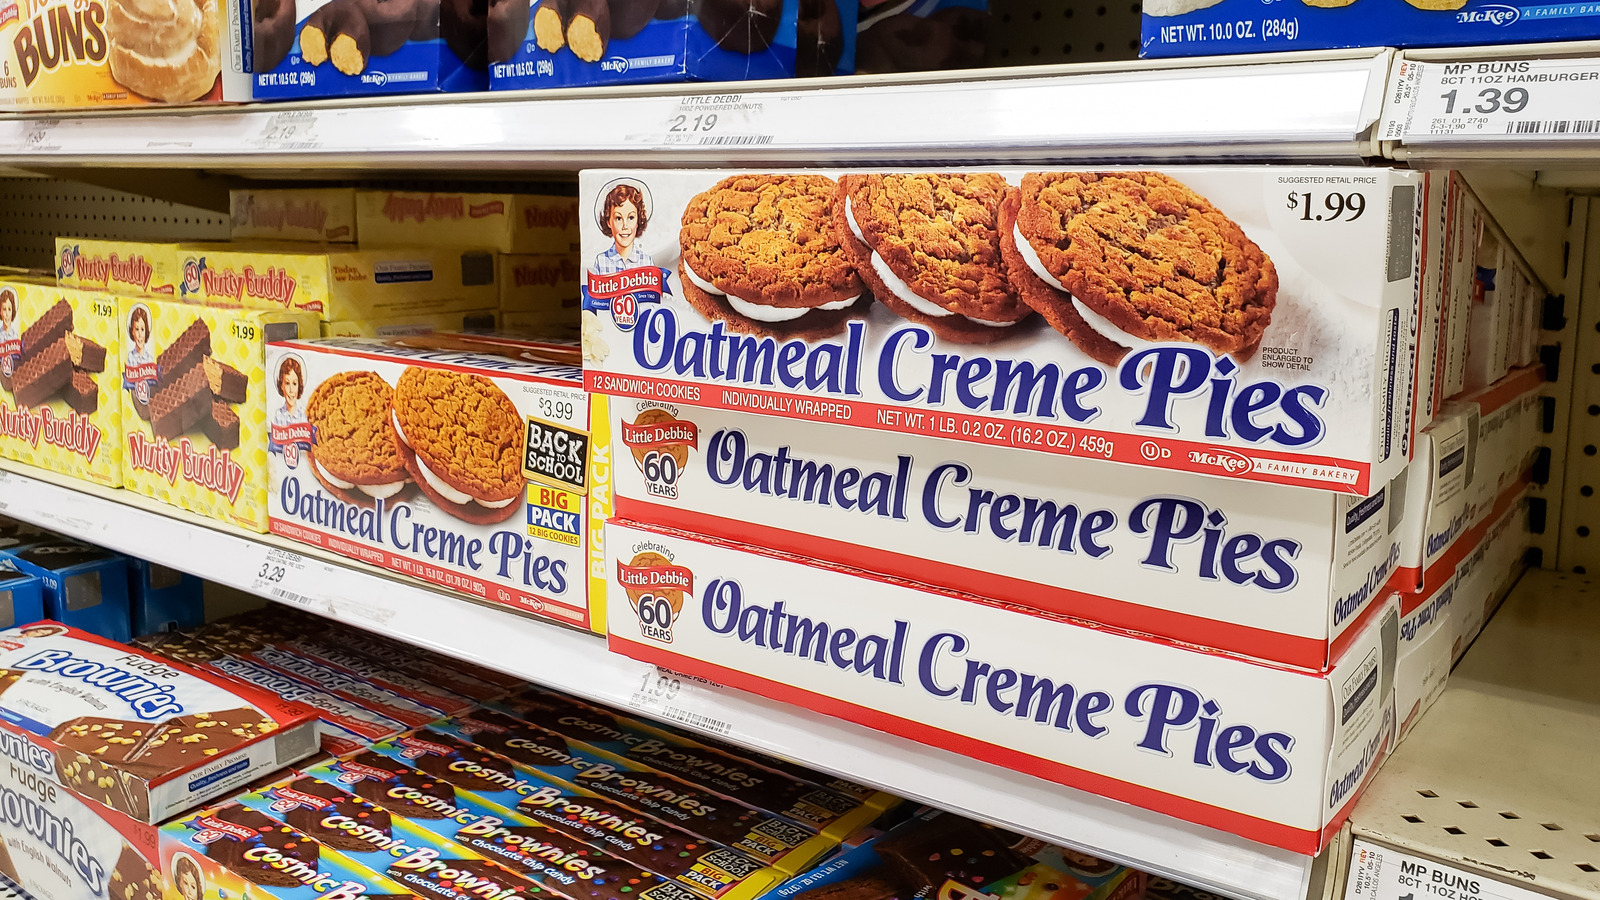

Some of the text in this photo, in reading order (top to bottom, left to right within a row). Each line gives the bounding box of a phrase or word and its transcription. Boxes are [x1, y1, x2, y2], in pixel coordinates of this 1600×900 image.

[1456, 10, 1515, 26] McKee
[1535, 6, 1575, 16] FAMILY
[1161, 17, 1299, 43] NET WT. 10.0 OZ. (284g)
[14, 2, 107, 88] BUNS
[4, 61, 10, 76] 6
[494, 62, 536, 79] NET WT. OZ.
[601, 61, 627, 74] McKee
[1399, 62, 1408, 77] REV
[1407, 63, 1416, 81] 05-10
[1443, 62, 1530, 75] MP BUNS
[0, 77, 17, 88] BUNS
[258, 73, 289, 86] NET WT. 10.5
[361, 74, 386, 86] McKee
[1440, 72, 1599, 85] 8CT HAMBURGER
[681, 96, 711, 105] LITTLE
[1440, 87, 1530, 114] 1.39
[266, 125, 297, 140] 2.19
[669, 113, 718, 132] 2.19
[1277, 176, 1377, 184] SUGGESTED RETAIL PRICE
[1286, 190, 1366, 222] $1.99
[76, 251, 154, 292] Nutty Buddy
[184, 264, 199, 283] 60
[202, 265, 297, 309] Nutty Buddy
[590, 272, 659, 294] Little Debbie
[93, 303, 113, 318] $1.99
[613, 296, 635, 317] 60
[615, 315, 635, 324] YEARS
[231, 323, 255, 341] $1.99
[1262, 346, 1298, 355] PRODUCT
[1262, 354, 1314, 364] ENLARGED TO
[633, 307, 865, 396] Oatmeal
[877, 327, 1102, 422] Creme
[1119, 346, 1326, 446] Pies
[1262, 361, 1311, 371] SHOW DETAIL
[522, 385, 587, 402] SUGGESTED RETAIL PRICE
[538, 397, 573, 421] $3.99
[592, 375, 1114, 458] 12 SANDWICH COOKIES INDIVIDUALLY WRAPPED NET WT. 1 LB. 0.2 OZ. (16.2 OZ.) 459g
[40, 404, 101, 464] Buddy
[272, 426, 311, 441] Little Debbie
[529, 422, 583, 466] BACK
[625, 426, 694, 444] Little Debbie
[285, 444, 297, 459] 60
[556, 453, 567, 463] TO
[128, 430, 245, 506] Nutty Buddy
[527, 451, 584, 484] SCHOOL
[643, 452, 677, 485] 60
[1188, 449, 1356, 482] McKee A FAMILY BAKERY
[592, 443, 610, 519] PACK
[646, 481, 677, 497] YEARS
[540, 488, 568, 510] BIG
[706, 429, 913, 521] Oatmeal
[922, 463, 1114, 559] Creme
[1128, 497, 1300, 590] Pies
[531, 506, 576, 534] PACK
[280, 475, 568, 594] Oatmeal Creme Pies
[529, 526, 578, 545] 12 BIG COOKIES
[302, 530, 425, 575] COOKIES WRAPPED NET WT. LB.
[631, 540, 676, 562] Celebrating
[258, 562, 286, 583] 3.29
[620, 569, 689, 587] Little Debbie
[1334, 571, 1371, 627] Oatmeal
[639, 595, 671, 629] 60
[641, 623, 671, 641] YEARS
[115, 653, 180, 680] Fudge
[11, 649, 184, 720] Brownies
[640, 671, 681, 700] 1.99
[701, 578, 909, 685] Oatmeal
[918, 632, 1111, 739] Creme
[1124, 683, 1295, 781] Pies
[188, 763, 223, 781] OUR FAMILY
[505, 738, 717, 818] Cosmic Brownies
[448, 759, 664, 847] Cosmic Brownies
[202, 816, 252, 839] Little Debbie
[320, 815, 415, 858] Cosmic
[386, 786, 606, 881] Cosmic Brownies
[533, 808, 636, 852] Chocolate Chip Candy
[740, 838, 777, 856] PACK
[753, 836, 778, 848] BIG
[7, 837, 72, 888] with Walnuts
[454, 833, 577, 886] with Chocolate Chip Candy
[714, 849, 759, 872] BACK
[1359, 848, 1368, 864] REV
[1367, 851, 1376, 871] 05-10
[1373, 853, 1383, 878] ANGELES
[242, 846, 337, 893] Cosmic
[385, 868, 402, 878] with
[699, 867, 725, 881] BIG
[705, 854, 747, 881] SCHOOL
[1400, 860, 1427, 877] MP
[1431, 869, 1481, 895] BUNS
[685, 870, 721, 890] PACK
[1398, 875, 1422, 889] 8CT
